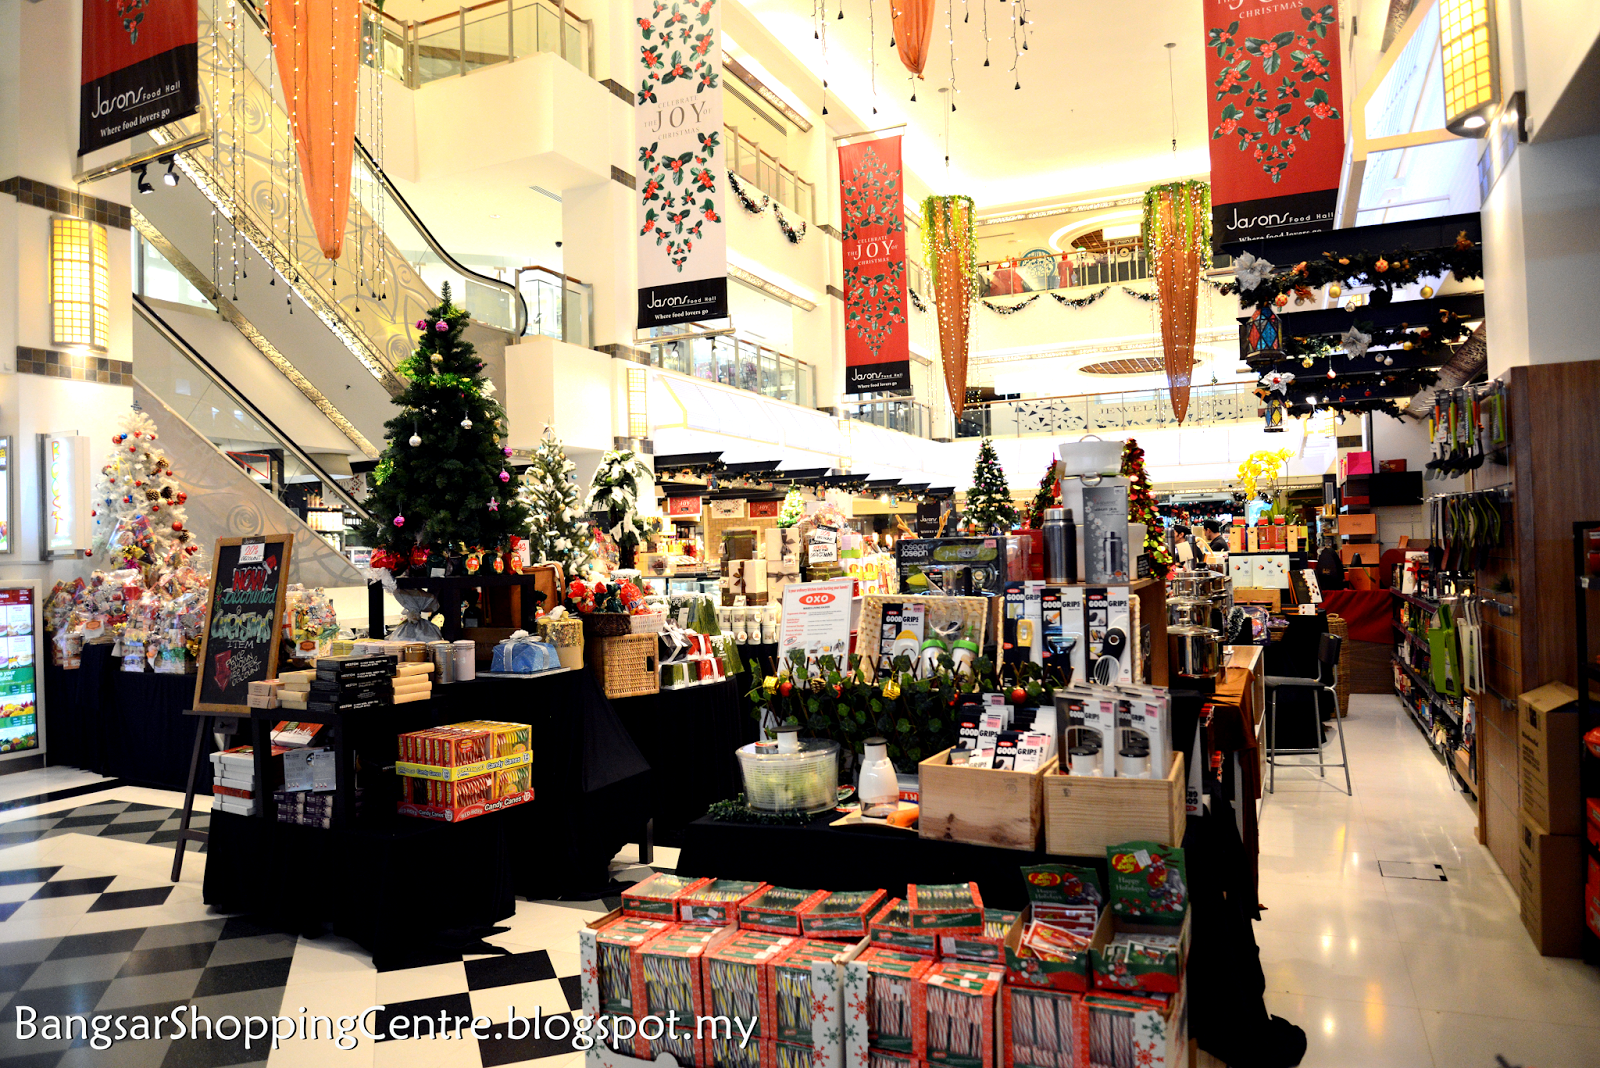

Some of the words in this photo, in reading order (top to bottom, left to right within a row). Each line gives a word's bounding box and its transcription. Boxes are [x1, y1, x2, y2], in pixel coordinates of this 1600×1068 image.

[1239, 1, 1303, 19] CHRISTMAS
[91, 86, 143, 118] Jasons
[142, 87, 161, 101] Food
[165, 80, 180, 93] Hall
[658, 95, 698, 108] CELEBRATE
[100, 124, 121, 137] Where
[122, 116, 138, 130] food
[139, 111, 160, 124] lovers
[161, 108, 170, 119] go
[651, 101, 706, 132] JOY
[658, 127, 700, 140] CHRISTMAS
[1226, 208, 1289, 230] Jasons
[1289, 215, 1310, 223] Food
[1316, 212, 1334, 220] Hall
[858, 236, 888, 244] CELEBRATE
[853, 240, 894, 260] JOY
[858, 257, 890, 265] CHRISTMAS
[647, 291, 688, 309] Jasons
[672, 310, 685, 318] food
[851, 368, 882, 381] Jasons
[1099, 401, 1196, 414] JEWELLEY
[900, 550, 929, 558] Joseph
[232, 568, 267, 592] NOW
[805, 594, 829, 604] OXO
[1043, 601, 1061, 609] GOOD
[226, 640, 254, 649] ITEM
[960, 728, 979, 736] GOOD
[979, 729, 998, 738] GRIPS
[997, 747, 1017, 755] GOOD
[486, 759, 504, 770] Candy
[504, 756, 521, 765] Canes
[484, 800, 503, 811] Candy
[504, 795, 521, 805] Canes
[418, 809, 431, 817] Candy
[1118, 877, 1140, 885] Happy
[1116, 884, 1145, 892] Holidays
